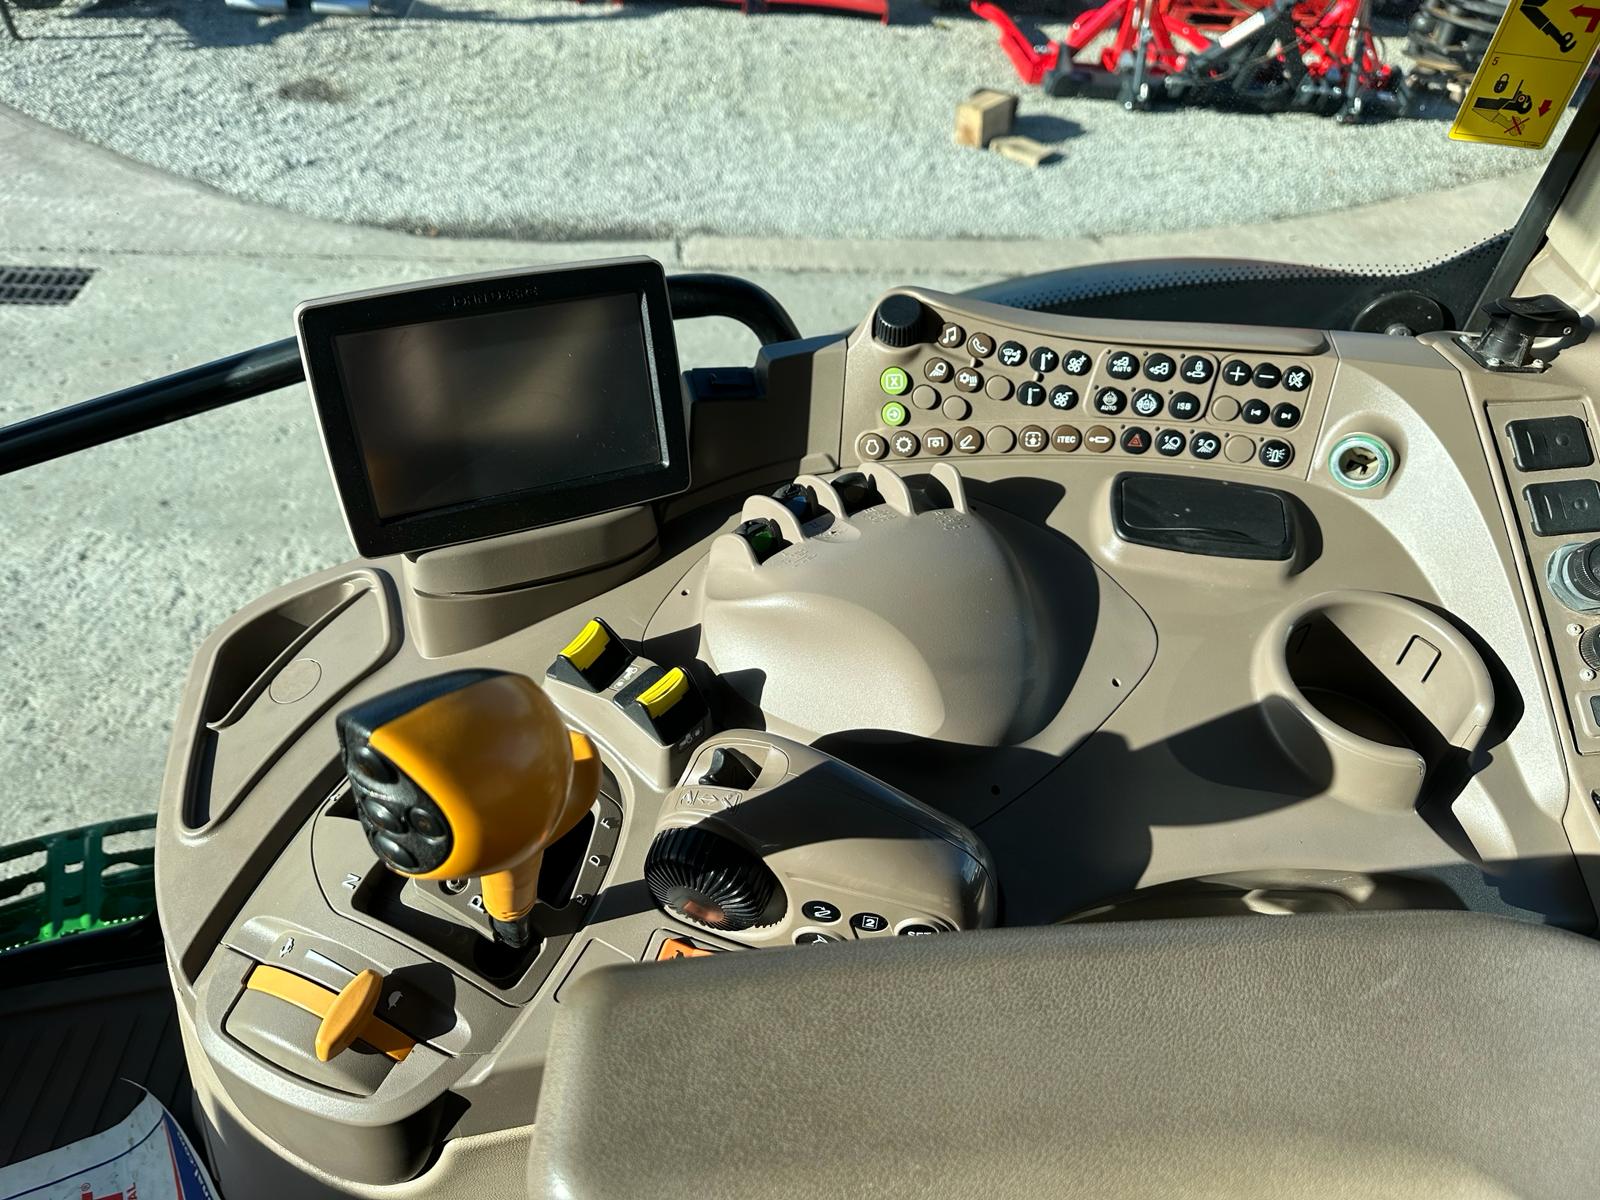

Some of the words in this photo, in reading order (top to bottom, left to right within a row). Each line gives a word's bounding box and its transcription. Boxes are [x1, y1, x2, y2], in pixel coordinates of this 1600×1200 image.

[1492, 56, 1500, 66] 5
[1112, 365, 1132, 373] AUTO
[1056, 435, 1077, 444] iTEC
[600, 817, 611, 830] F
[588, 854, 601, 868] D
[341, 872, 362, 890] N
[467, 894, 486, 914] P
[865, 918, 875, 928] 2
